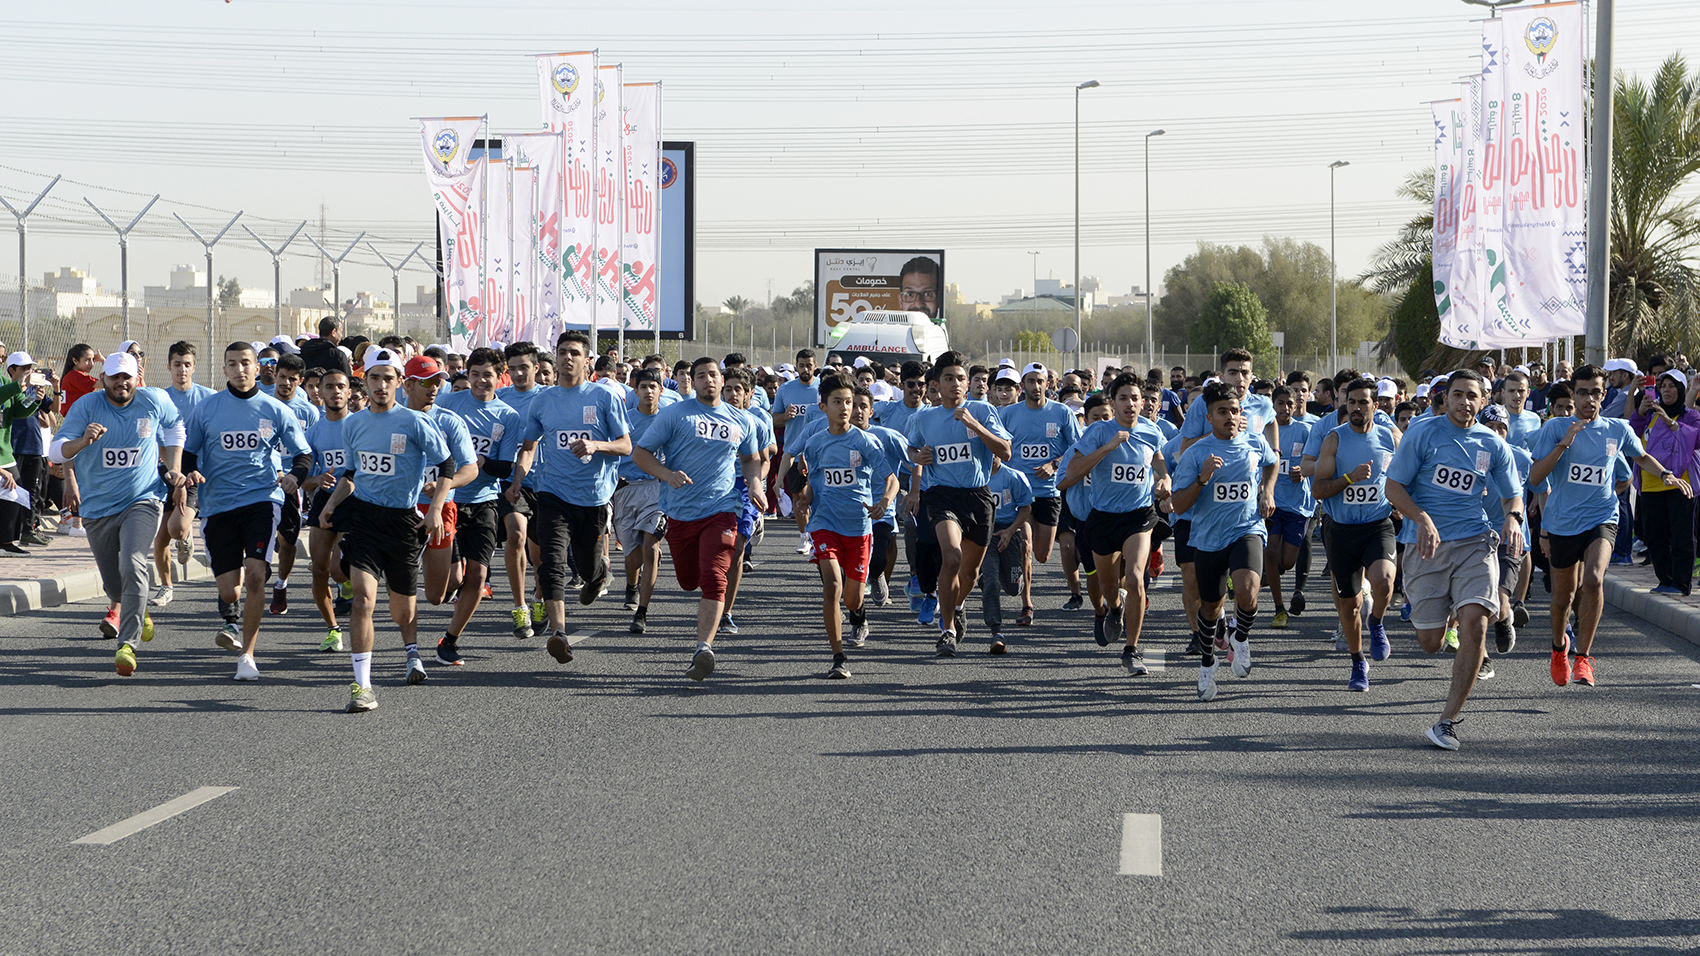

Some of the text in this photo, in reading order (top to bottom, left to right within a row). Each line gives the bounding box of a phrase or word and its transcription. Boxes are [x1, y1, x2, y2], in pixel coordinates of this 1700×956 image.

[855, 277, 887, 287] خصومات
[846, 344, 907, 353] AMBULANCE
[698, 421, 729, 439] 978
[223, 433, 258, 450] 986
[105, 449, 140, 466] 997
[325, 451, 346, 467] 95
[938, 444, 970, 462] 904
[1022, 445, 1048, 458] 928
[361, 453, 393, 474] 935
[825, 469, 854, 485] 905
[1114, 465, 1145, 482] 964
[1436, 467, 1474, 491] 989
[1571, 465, 1603, 484] 921
[1217, 483, 1249, 501] 958
[1345, 486, 1378, 503] 992
